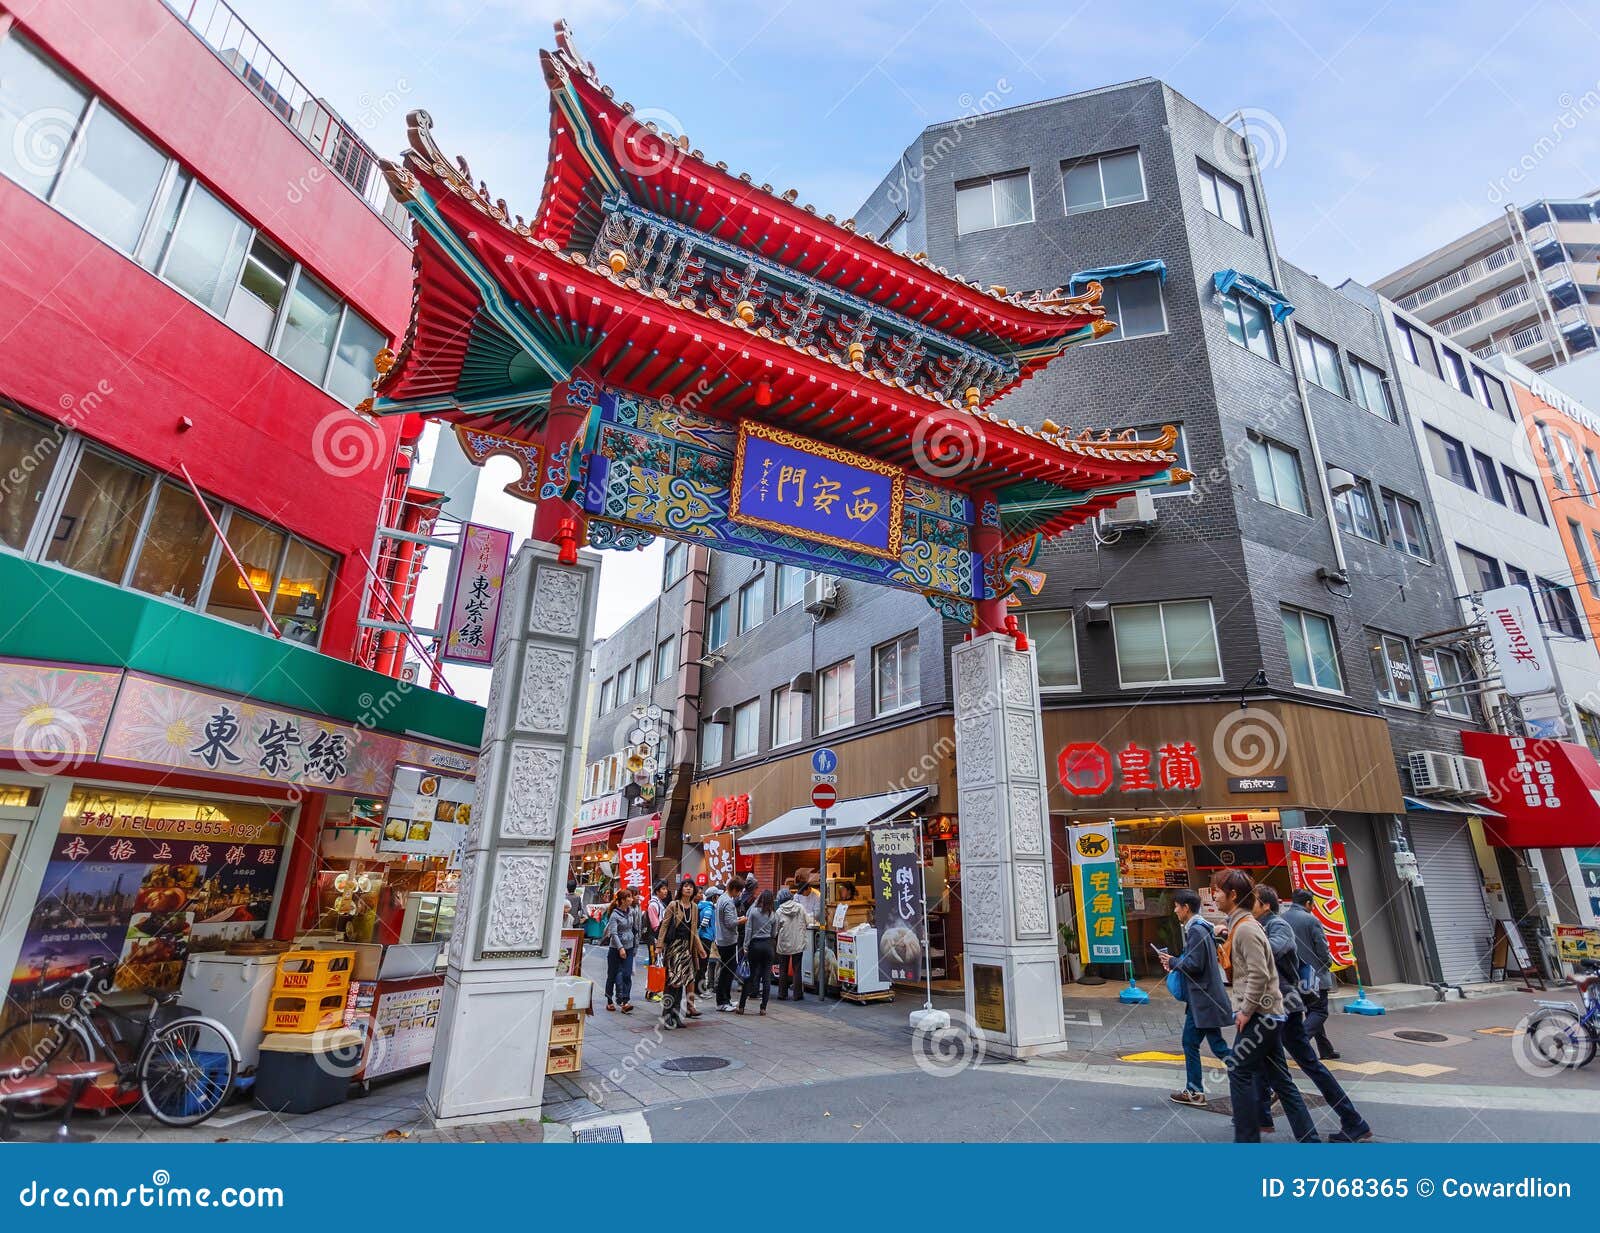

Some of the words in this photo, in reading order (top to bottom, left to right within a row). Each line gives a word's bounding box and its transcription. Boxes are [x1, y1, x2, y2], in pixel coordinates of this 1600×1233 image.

[777, 465, 878, 522] 西安門
[191, 706, 347, 782] 東紫縁
[1117, 742, 1202, 792] 皇蘭
[79, 811, 113, 828] 予約
[62, 838, 277, 865] 本格上海料理
[623, 848, 648, 899] 中華
[1089, 871, 1116, 938] 宅急便
[283, 975, 309, 985] KIRIN
[275, 1014, 300, 1023] KIRIN
